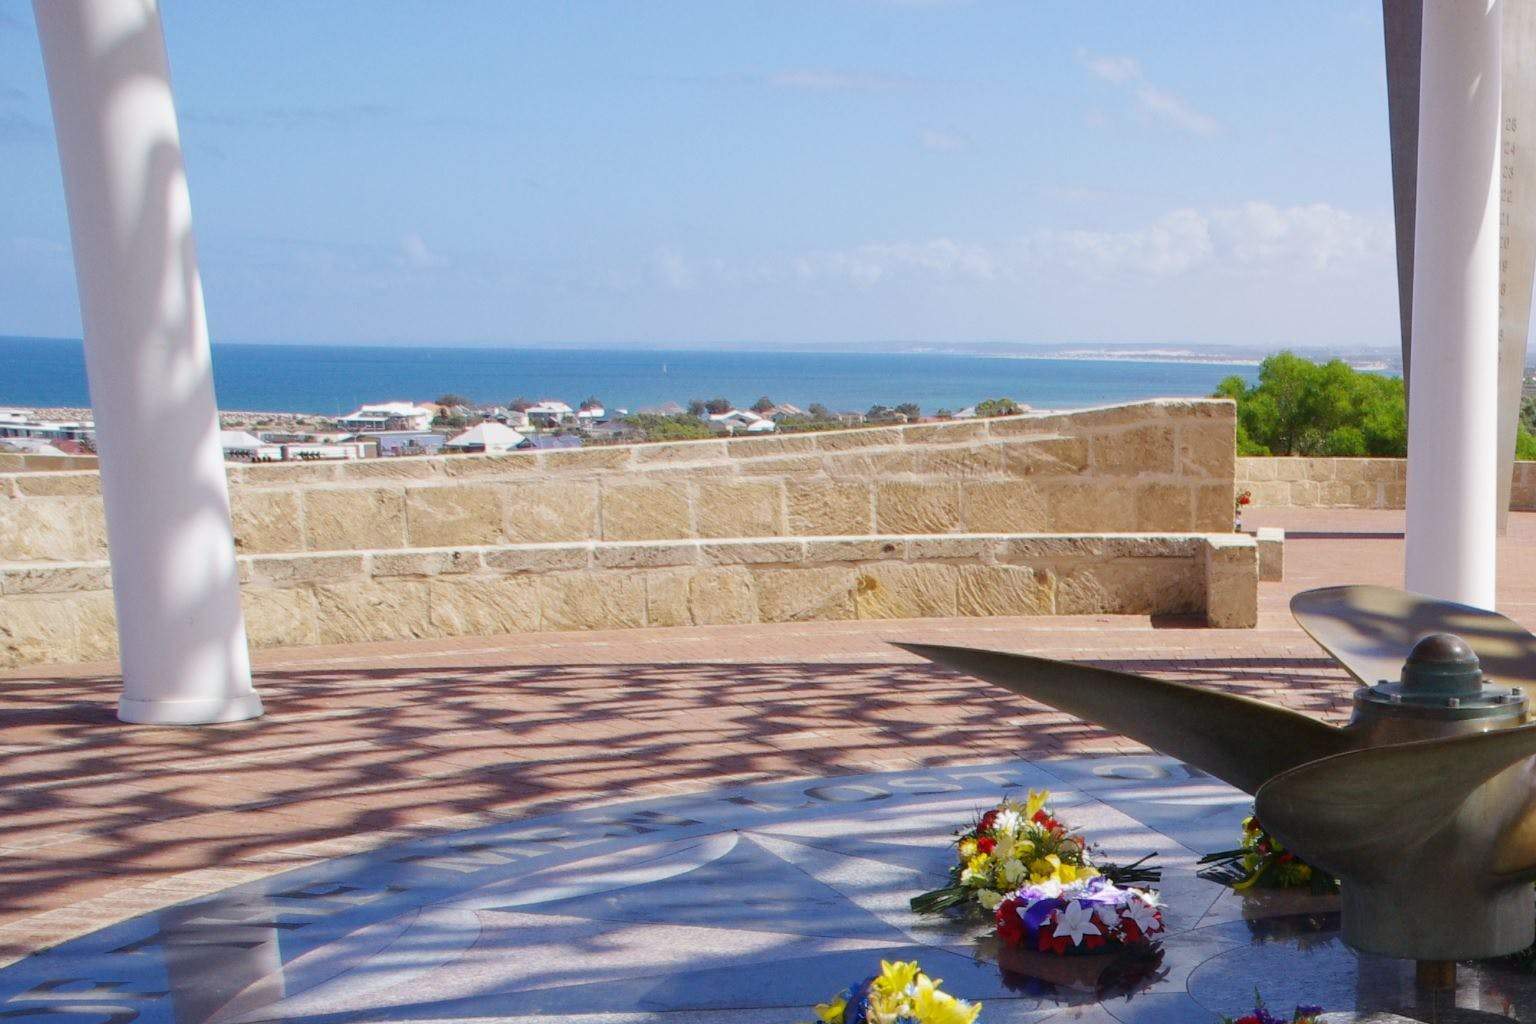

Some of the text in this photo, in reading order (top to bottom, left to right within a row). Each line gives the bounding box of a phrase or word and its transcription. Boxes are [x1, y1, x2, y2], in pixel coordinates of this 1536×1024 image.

[104, 880, 410, 955] THE
[388, 811, 704, 873] MEN
[720, 769, 1023, 813] LOST
[1093, 764, 1193, 780] O
